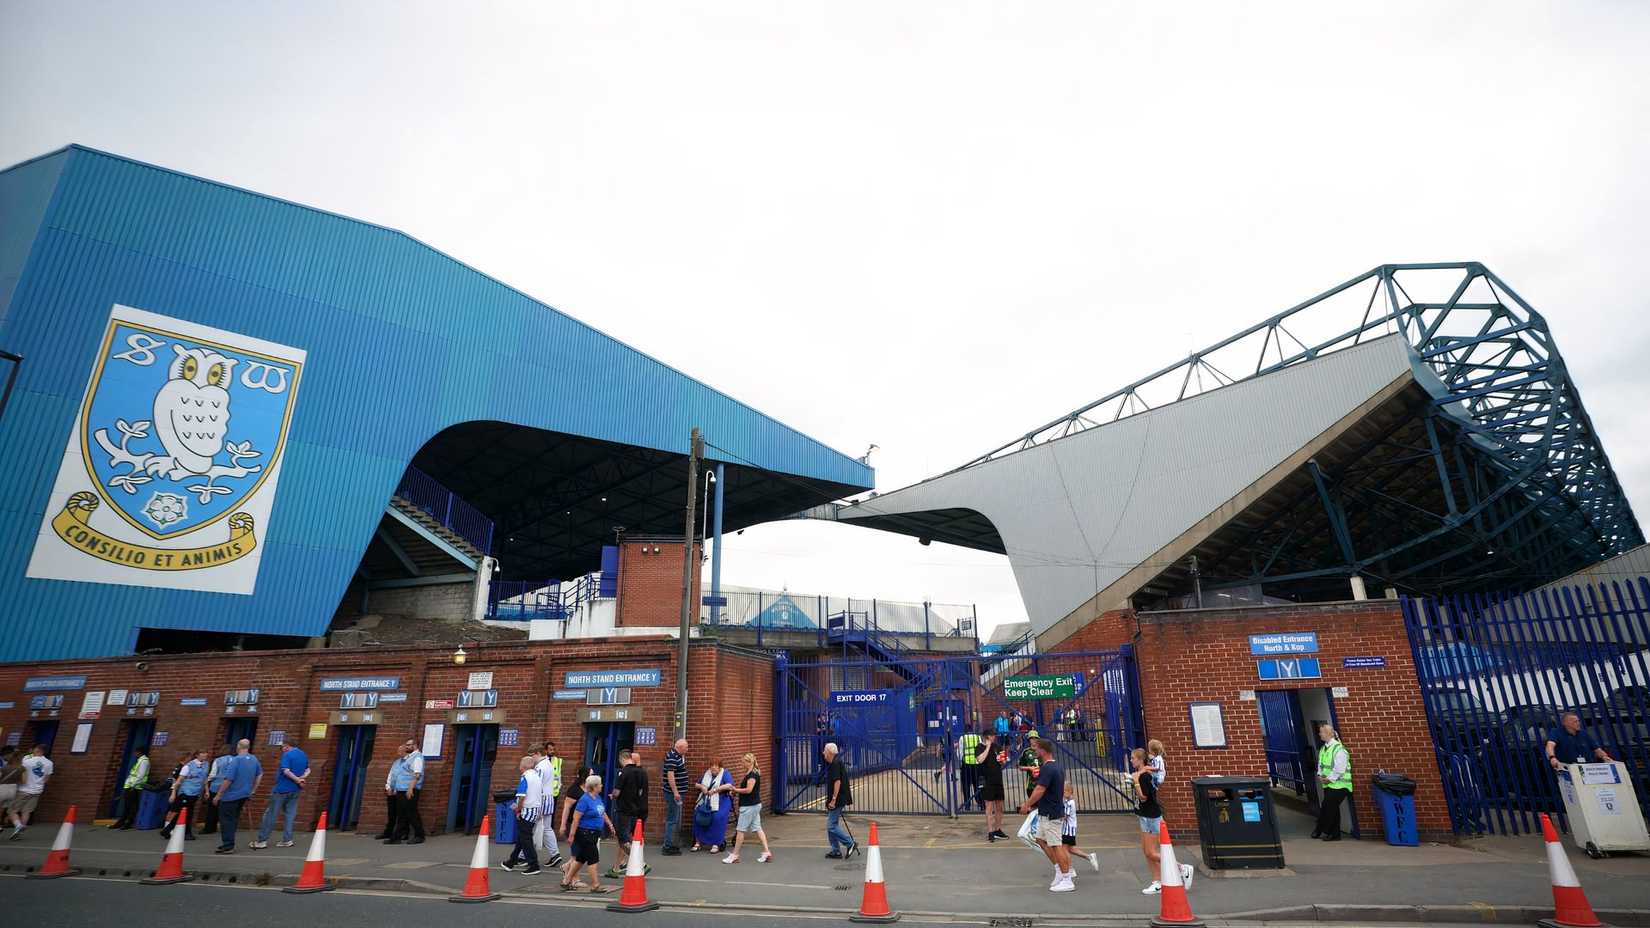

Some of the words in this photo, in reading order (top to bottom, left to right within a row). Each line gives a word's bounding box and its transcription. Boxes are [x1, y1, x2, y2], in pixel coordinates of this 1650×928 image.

[64, 525, 145, 565] CONSILIO
[154, 554, 175, 567] ET
[181, 542, 243, 566] ANIMIS
[1253, 636, 1281, 645] Disabled
[1282, 635, 1313, 643] Entrance
[1264, 644, 1283, 652] North
[1291, 643, 1305, 652] Kop
[1280, 661, 1294, 677] Y
[360, 679, 390, 688] ENTRANCE
[568, 674, 591, 684] NORTH
[591, 674, 614, 684] STAND
[615, 673, 650, 682] ENTRANCE
[650, 672, 657, 682] Y
[1004, 679, 1054, 689] Emergency
[1055, 677, 1073, 686] Exit
[461, 690, 471, 704] Y
[487, 690, 496, 704] Y
[604, 687, 615, 702] Y
[854, 694, 877, 702] DOOR
[879, 693, 887, 701] 17
[1005, 688, 1028, 698] Keep
[1030, 687, 1054, 696] Clear
[345, 693, 353, 705] Y
[368, 693, 377, 705] Y
